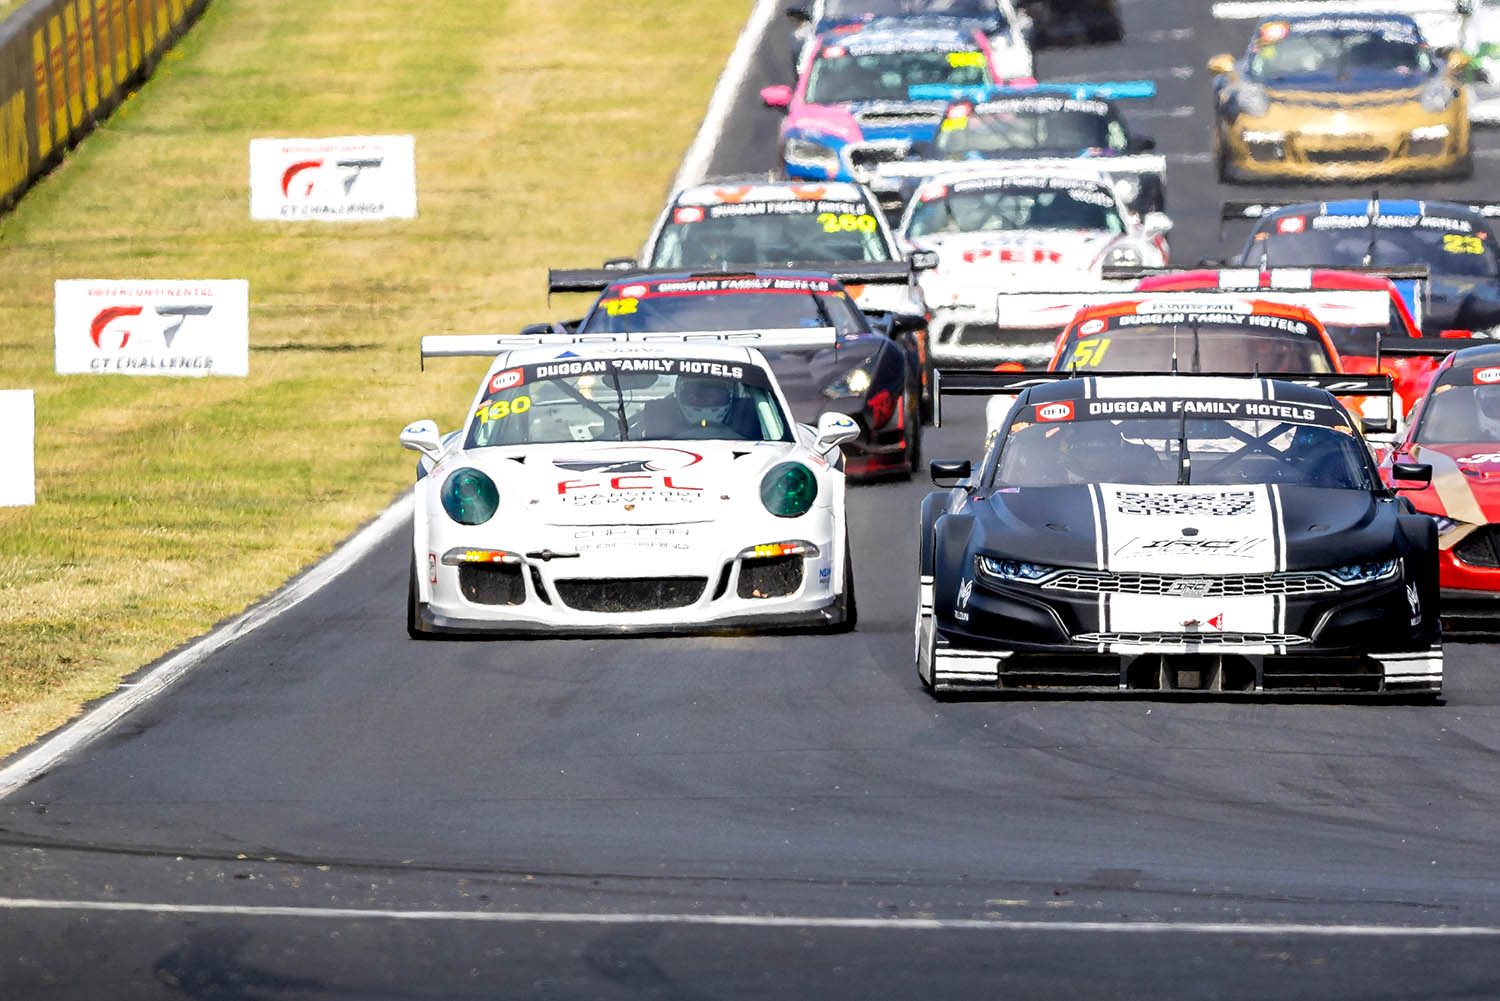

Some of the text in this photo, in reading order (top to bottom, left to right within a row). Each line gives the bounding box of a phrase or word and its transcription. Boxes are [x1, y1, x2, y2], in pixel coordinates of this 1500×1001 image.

[1120, 312, 1308, 335] DUGGAN FAMILY HOTELS
[117, 355, 214, 369] CHALLENGE
[1067, 338, 1111, 368] 51
[536, 359, 743, 379] DUGGAN FAMILY HOTELS
[1089, 401, 1166, 414] DUGGAN
[1172, 400, 1240, 414] FAMILY
[1246, 402, 1315, 420] HOTELS
